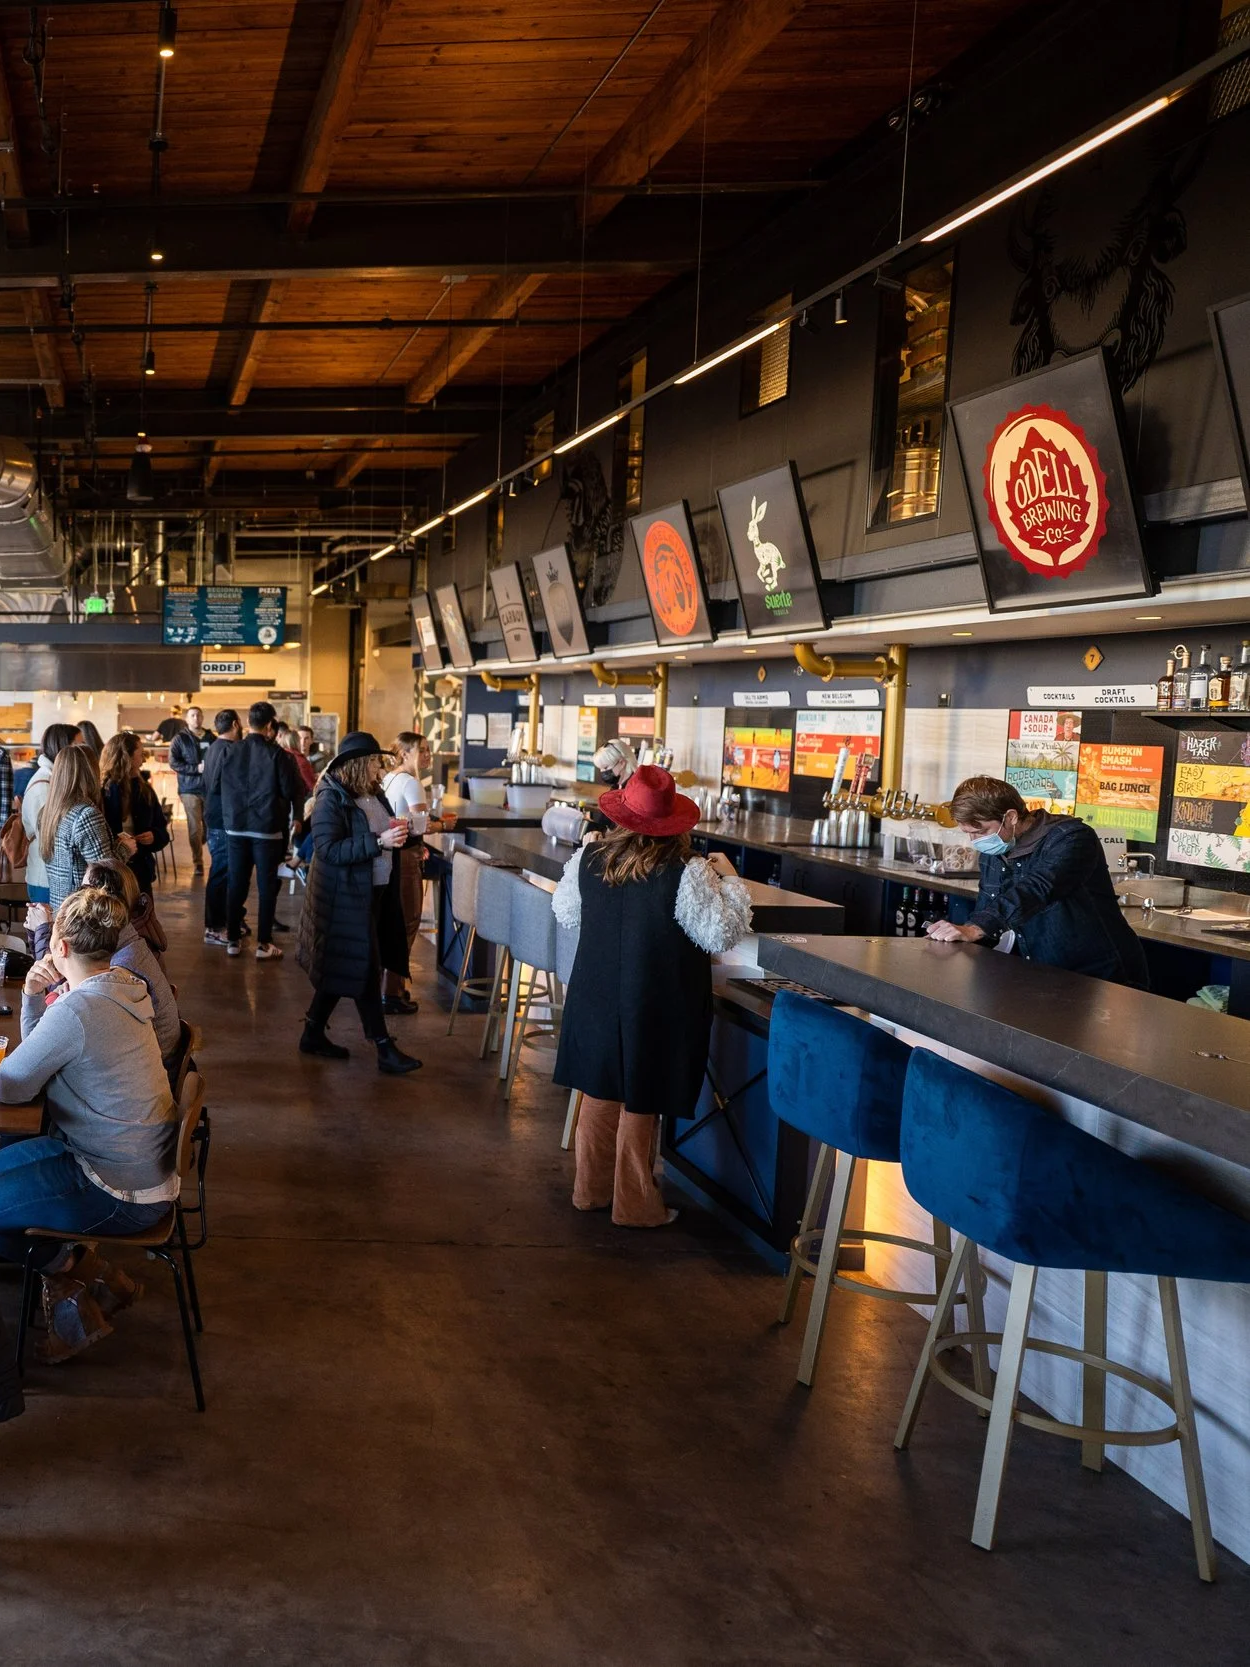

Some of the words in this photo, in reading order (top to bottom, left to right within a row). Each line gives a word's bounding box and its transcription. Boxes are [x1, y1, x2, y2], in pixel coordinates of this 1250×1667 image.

[1014, 447, 1080, 509] ODELL
[1020, 500, 1081, 531] BREWING
[1090, 654, 1095, 663] 7
[1043, 693, 1076, 701] COCKTAILS
[1101, 688, 1126, 696] DRAFT
[1094, 696, 1136, 704] COCKTAILS
[1024, 714, 1054, 724] CANADA
[1028, 724, 1048, 733] SOUR
[1186, 736, 1218, 752] HAZER
[1102, 746, 1143, 756] RUMPKIN
[1190, 747, 1210, 757] TAG
[1101, 755, 1133, 765] SMASH
[1007, 769, 1036, 782] RODEO
[1180, 766, 1205, 780] EASY
[1009, 777, 1052, 791] MONADE
[1099, 782, 1117, 791] BAG
[1119, 782, 1151, 794] LUNCH
[1176, 780, 1207, 796] STREET
[1097, 808, 1153, 829] NORTHSIDE
